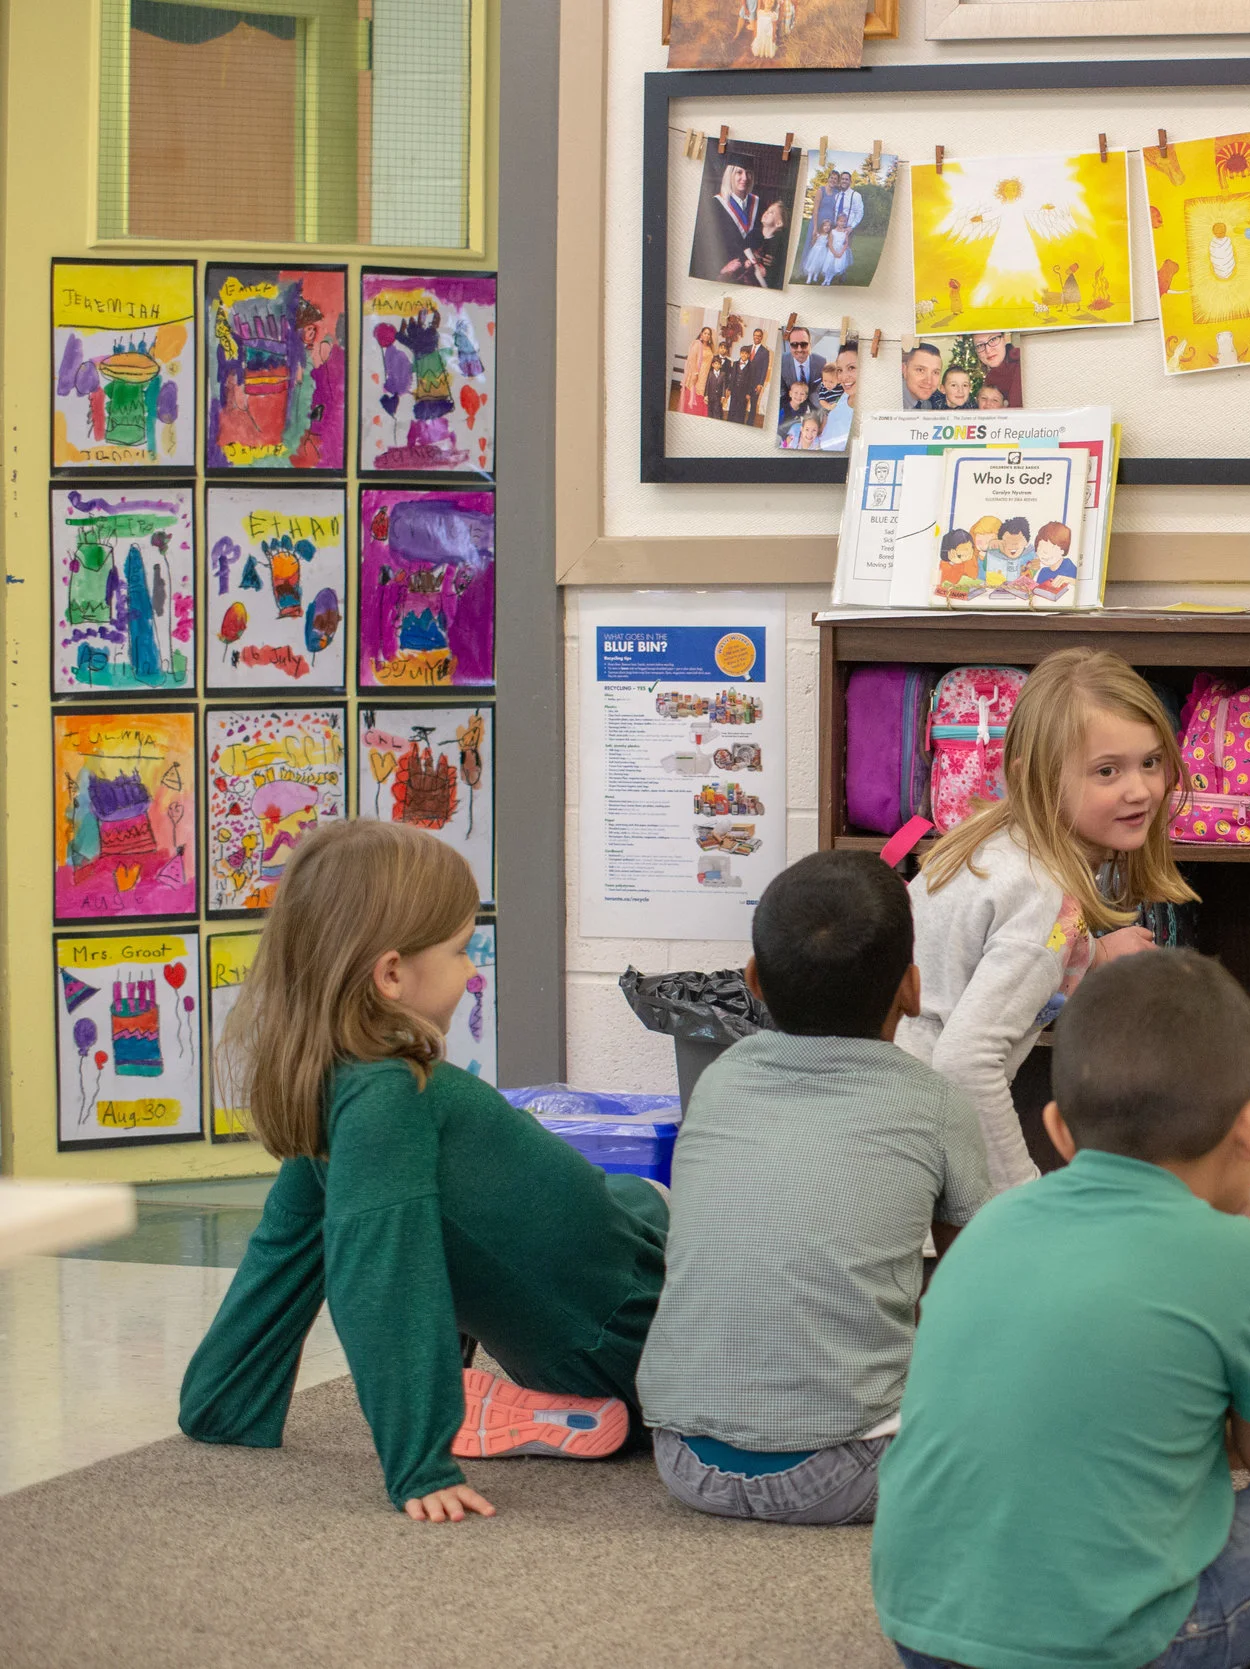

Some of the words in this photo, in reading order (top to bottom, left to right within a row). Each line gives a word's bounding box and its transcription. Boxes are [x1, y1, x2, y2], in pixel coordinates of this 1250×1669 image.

[62, 288, 161, 319] JEREMIAH
[910, 429, 929, 440] The
[932, 425, 987, 440] ZONES
[990, 427, 1001, 440] of
[973, 471, 1002, 485] Who
[1005, 472, 1015, 485] Is
[1019, 472, 1053, 485] God?
[870, 516, 888, 524] BLUE
[866, 561, 887, 569] Moving
[604, 633, 624, 641] WHAT
[625, 633, 646, 641] GOES
[646, 633, 654, 641] IN
[655, 633, 668, 641] THE
[604, 641, 634, 653] BLUE
[637, 641, 668, 653] BIN?
[73, 946, 113, 963] Mrs.
[121, 943, 173, 960] Groot
